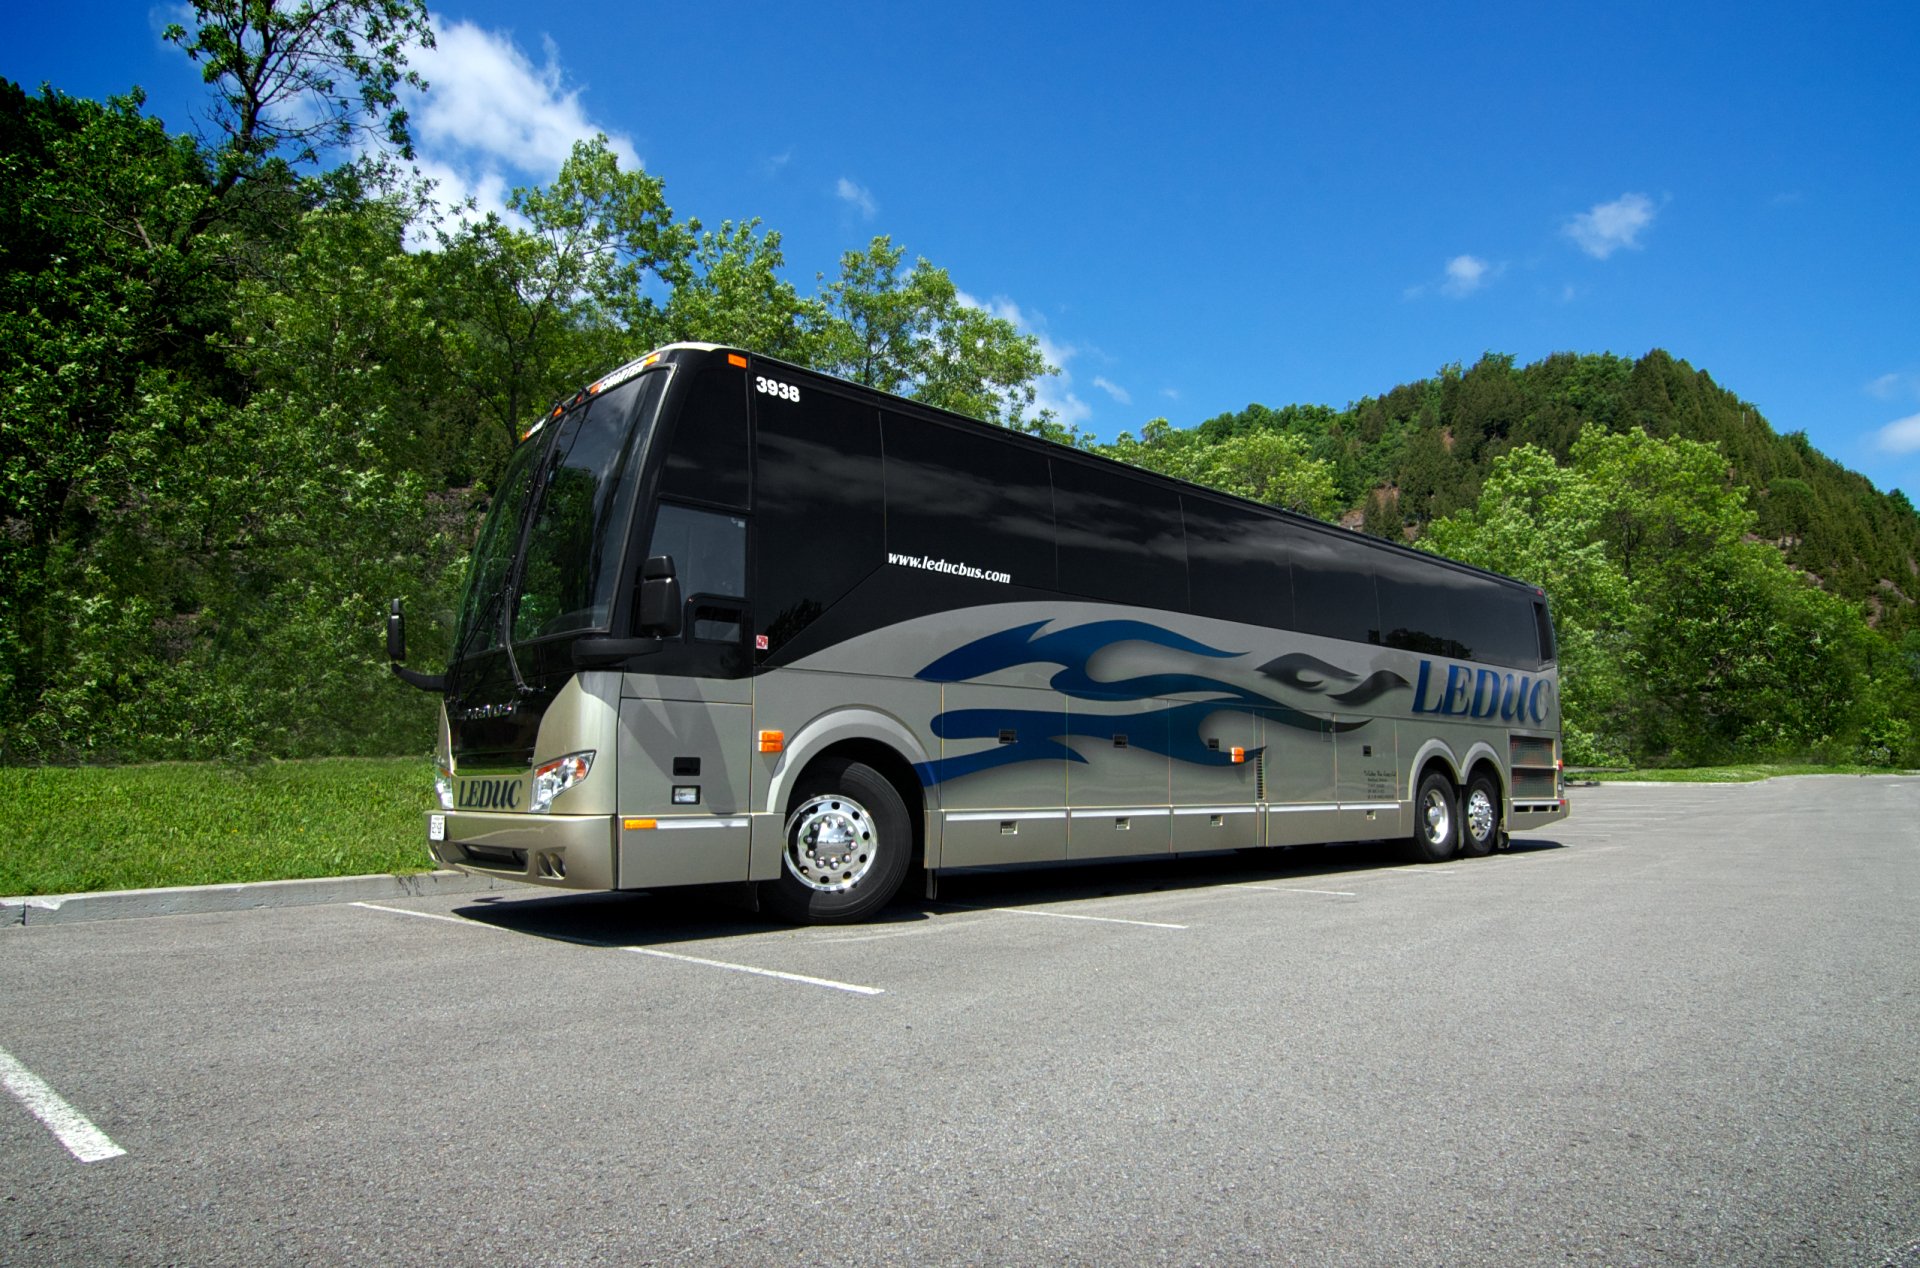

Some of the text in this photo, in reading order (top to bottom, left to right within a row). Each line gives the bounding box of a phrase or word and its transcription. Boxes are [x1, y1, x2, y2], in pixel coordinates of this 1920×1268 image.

[756, 376, 800, 402] 3938
[888, 552, 1011, 584] www.leducbus.com
[1411, 659, 1551, 723] LEDUC
[458, 779, 522, 809] LEDUC
